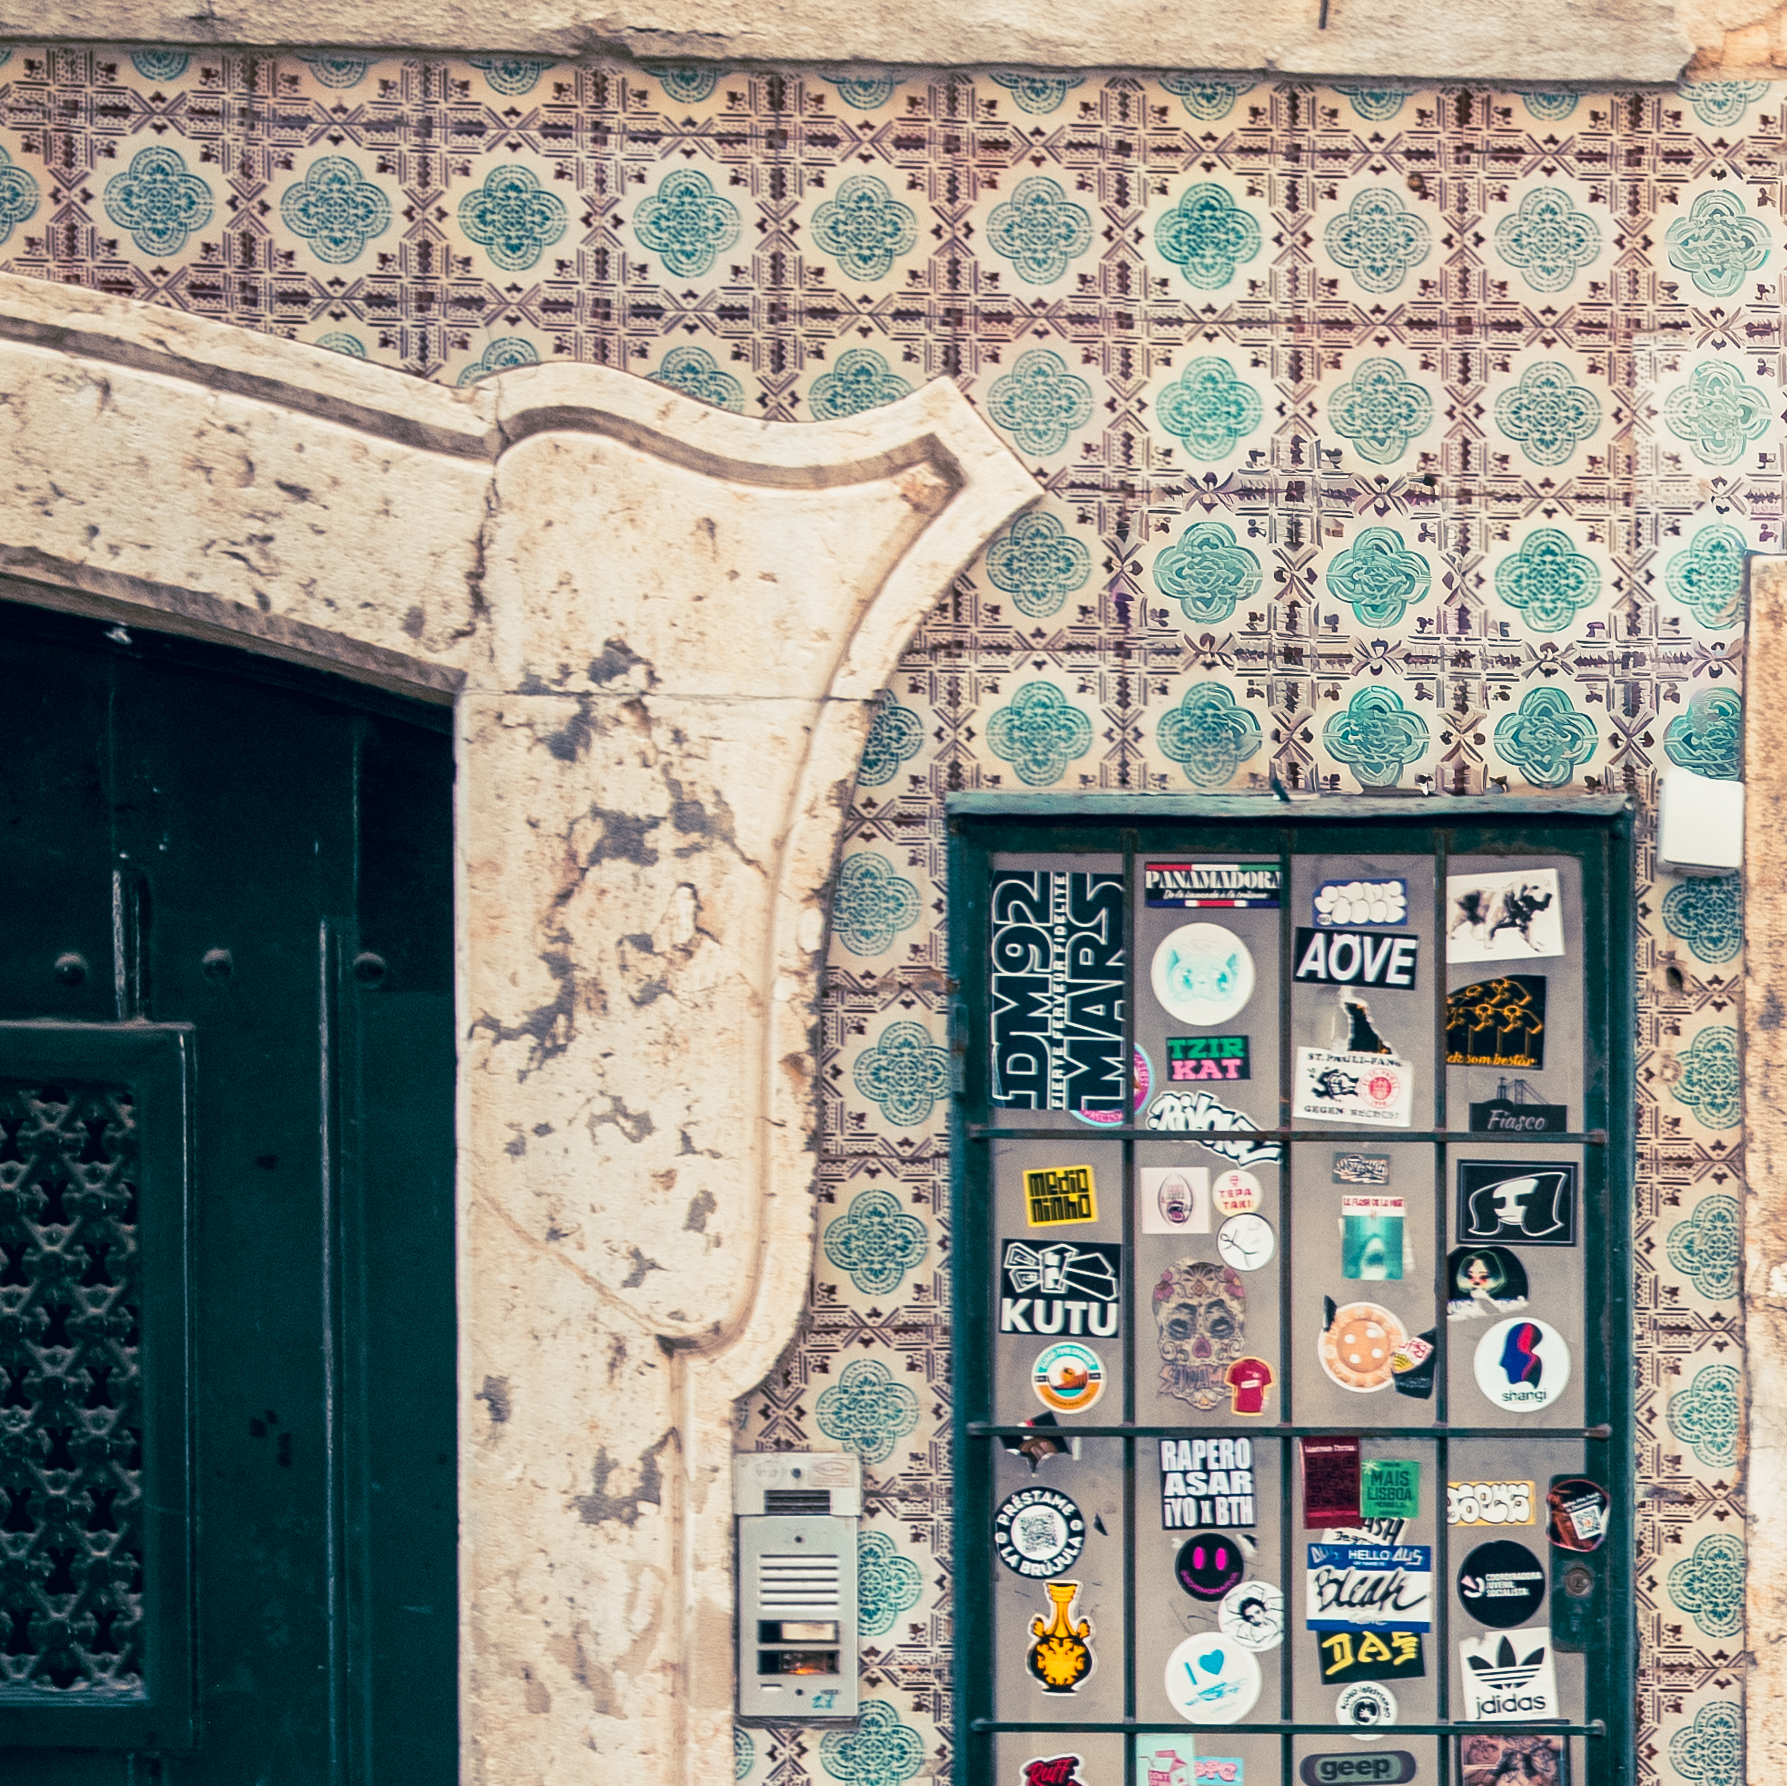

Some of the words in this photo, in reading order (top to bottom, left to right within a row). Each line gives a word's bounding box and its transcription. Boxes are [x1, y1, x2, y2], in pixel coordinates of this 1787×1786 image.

[1053, 874, 1067, 953] FIDELITE
[1052, 960, 1066, 1038] FERVEUR
[1167, 1037, 1245, 1060] TZIR
[1467, 1053, 1491, 1064] som
[1171, 1059, 1243, 1080] KAT
[1304, 1105, 1344, 1115] GEGEN
[1487, 1109, 1546, 1131] Fiasco
[1219, 1188, 1252, 1199] TEPA
[1222, 1200, 1252, 1210] TAKI
[1001, 1297, 1119, 1337] KUTU
[1501, 1388, 1548, 1403] shangi
[1161, 1438, 1251, 1472] RAPERO
[1164, 1471, 1252, 1497] ASAR
[1370, 1470, 1410, 1487] MAIS
[1366, 1487, 1413, 1501] LISBOA
[1215, 1496, 1254, 1527] BTH
[1001, 1546, 1019, 1569] LA
[1348, 1550, 1391, 1560] HELLO
[1475, 1694, 1547, 1720] jdidas
[1320, 1759, 1392, 1781] geep
